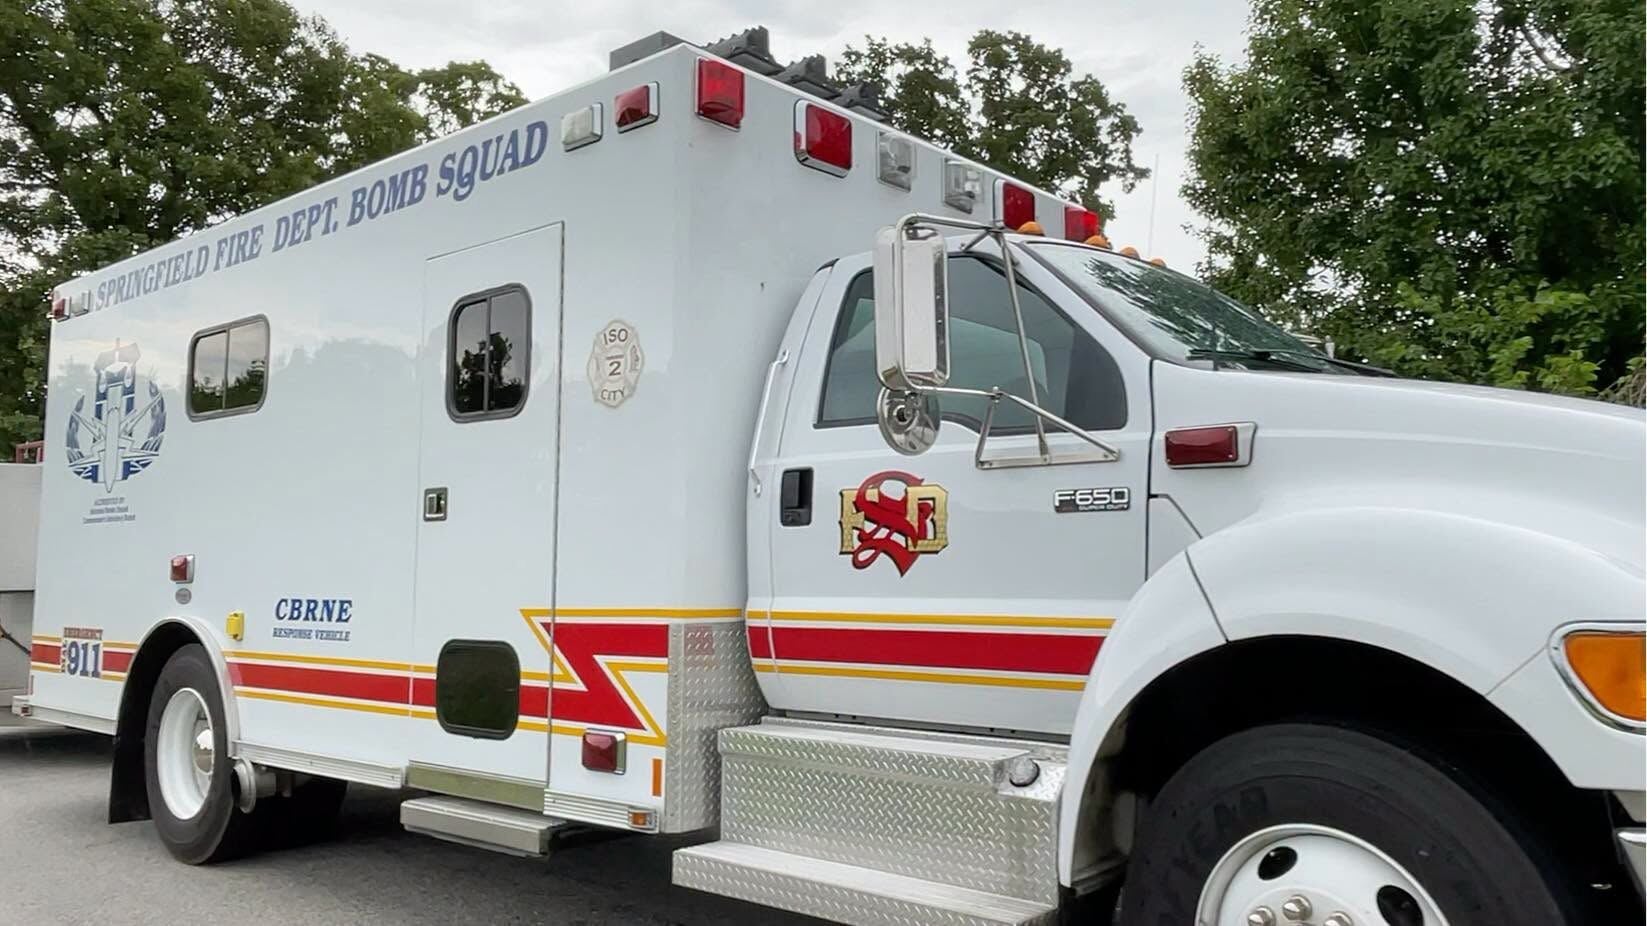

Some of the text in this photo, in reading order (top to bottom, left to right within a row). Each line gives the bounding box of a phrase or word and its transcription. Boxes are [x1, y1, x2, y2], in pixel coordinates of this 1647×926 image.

[96, 120, 548, 311] SPRINGFIELD FIRE DEPT. BOMB SQUAD
[603, 328, 628, 345] ISO
[609, 361, 621, 376] 2
[601, 386, 625, 401] CITY
[275, 598, 352, 623] CBRNE
[67, 641, 101, 678] 911
